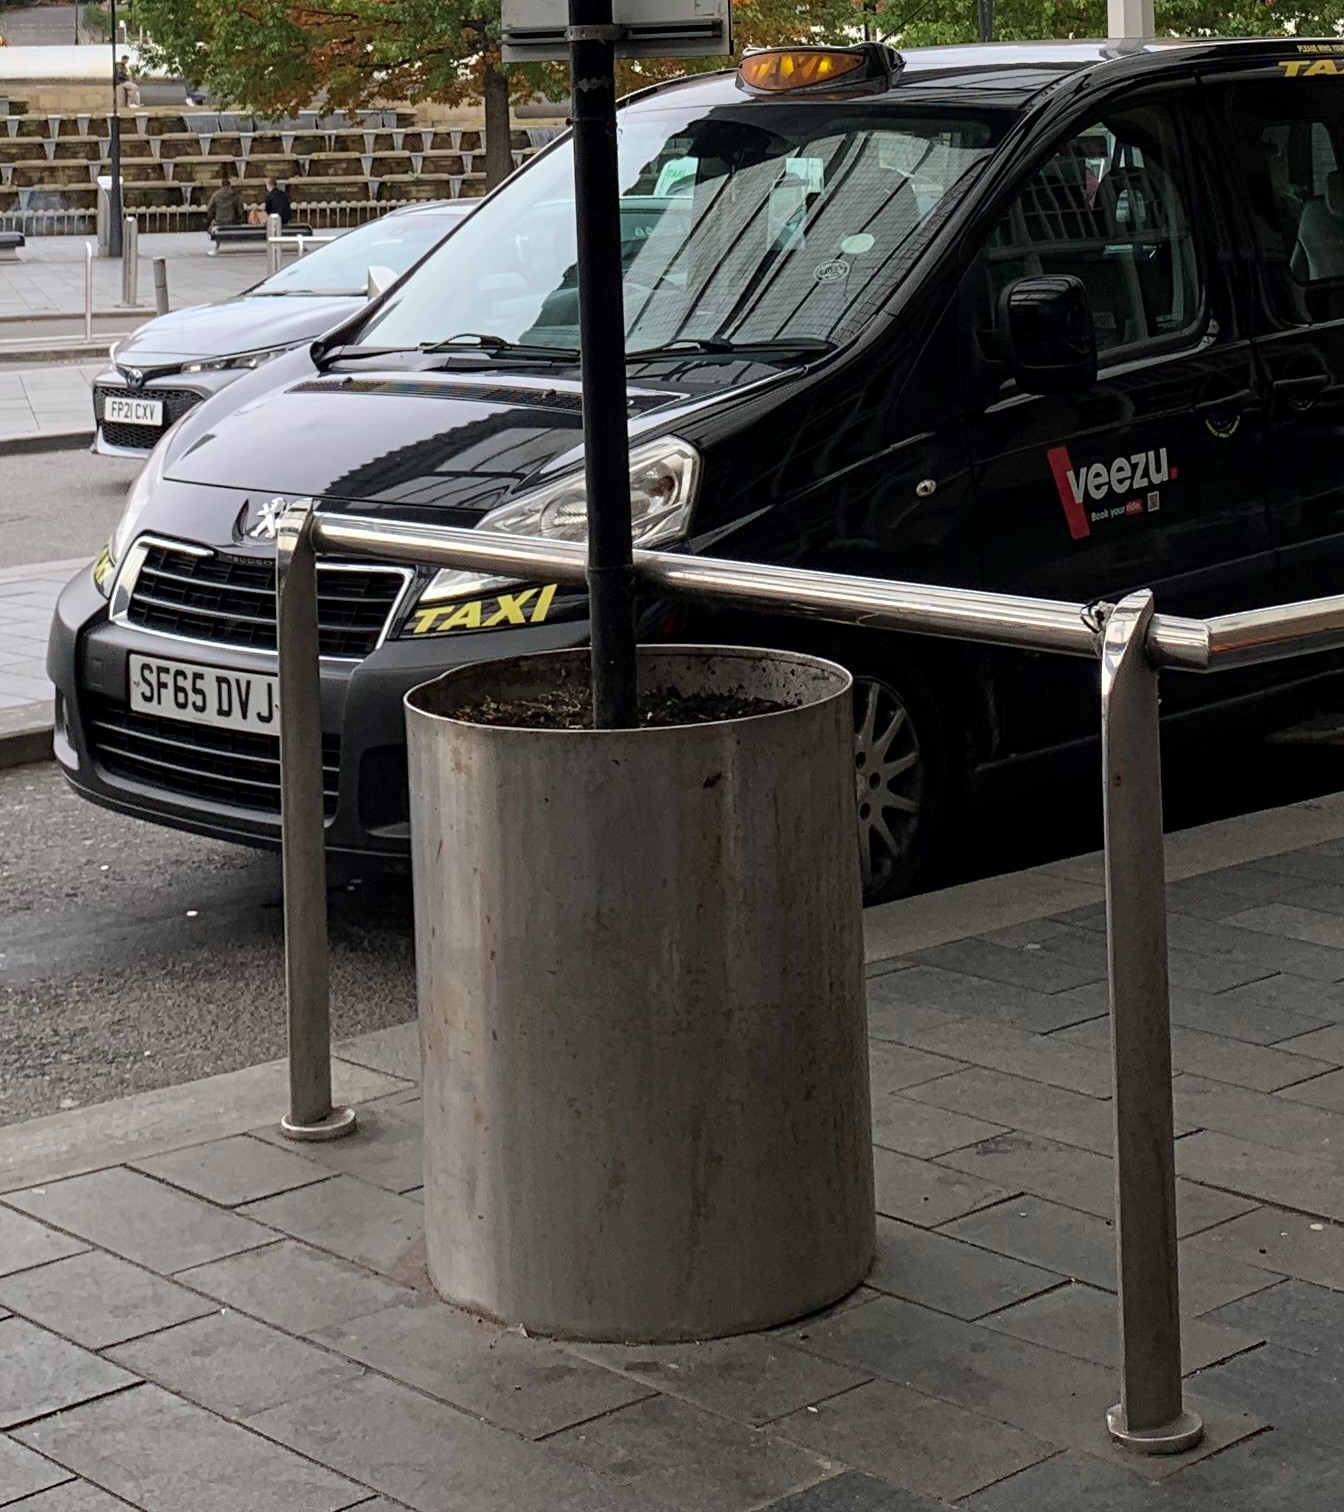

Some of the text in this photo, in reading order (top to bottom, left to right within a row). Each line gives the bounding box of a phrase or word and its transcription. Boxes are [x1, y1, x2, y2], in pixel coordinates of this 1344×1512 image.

[111, 400, 156, 421] FP21 CXV
[1091, 509, 1109, 522] Book
[1110, 506, 1126, 519] your
[413, 583, 557, 634] TAXI
[140, 662, 274, 724] SF65 DVJ
